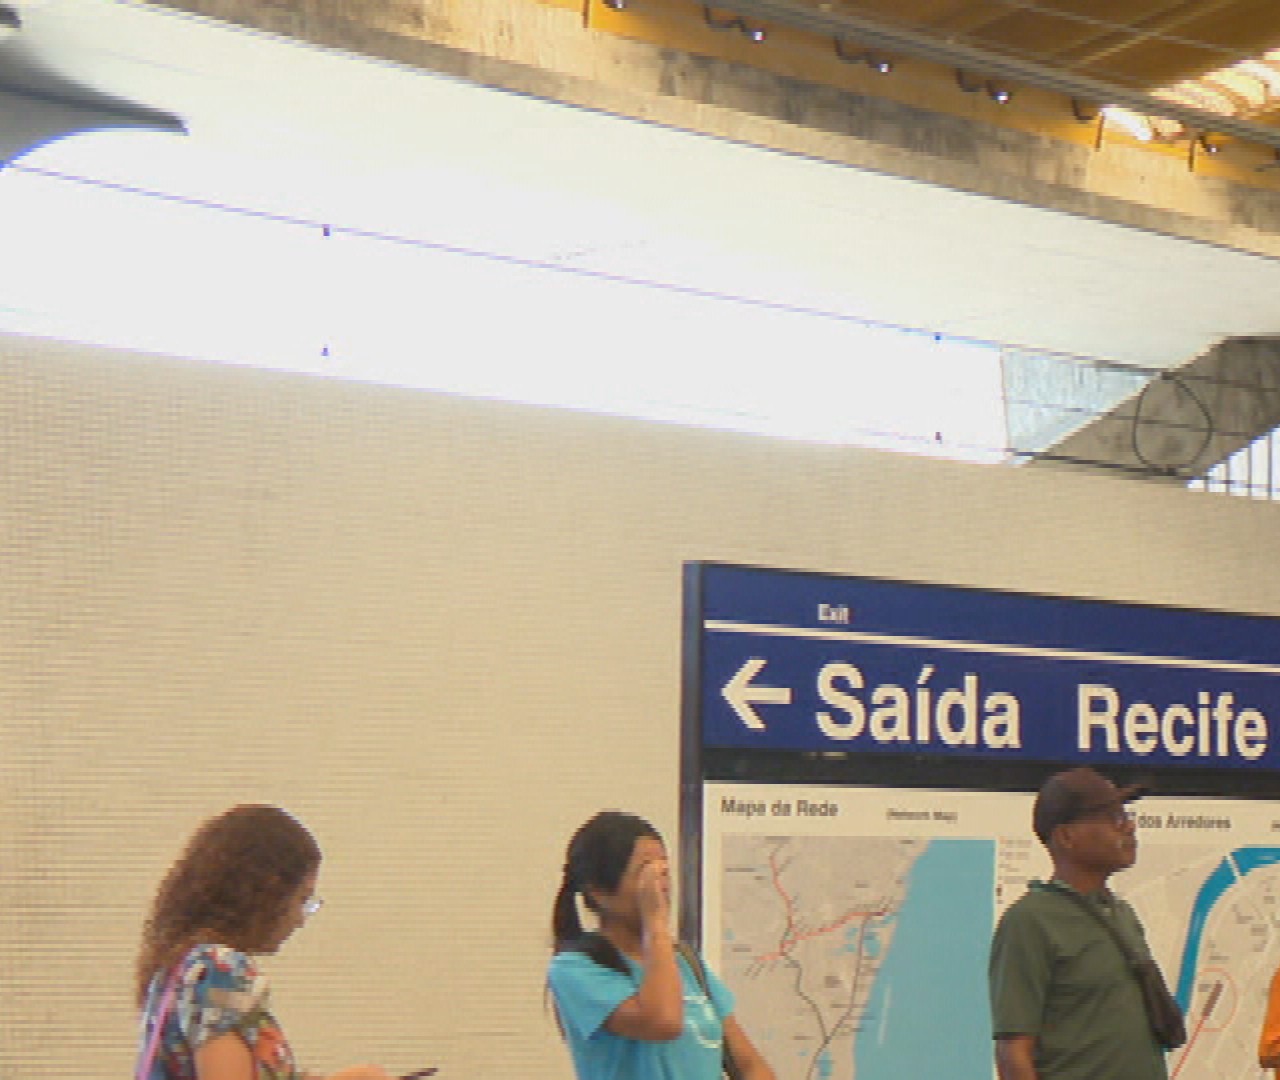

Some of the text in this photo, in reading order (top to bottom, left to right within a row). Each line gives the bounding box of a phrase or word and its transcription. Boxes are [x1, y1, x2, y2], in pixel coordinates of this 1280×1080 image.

[817, 603, 849, 625] Exit
[815, 660, 1267, 760] Saída Recife
[721, 796, 766, 820] Mapa
[797, 799, 839, 818] Rede
